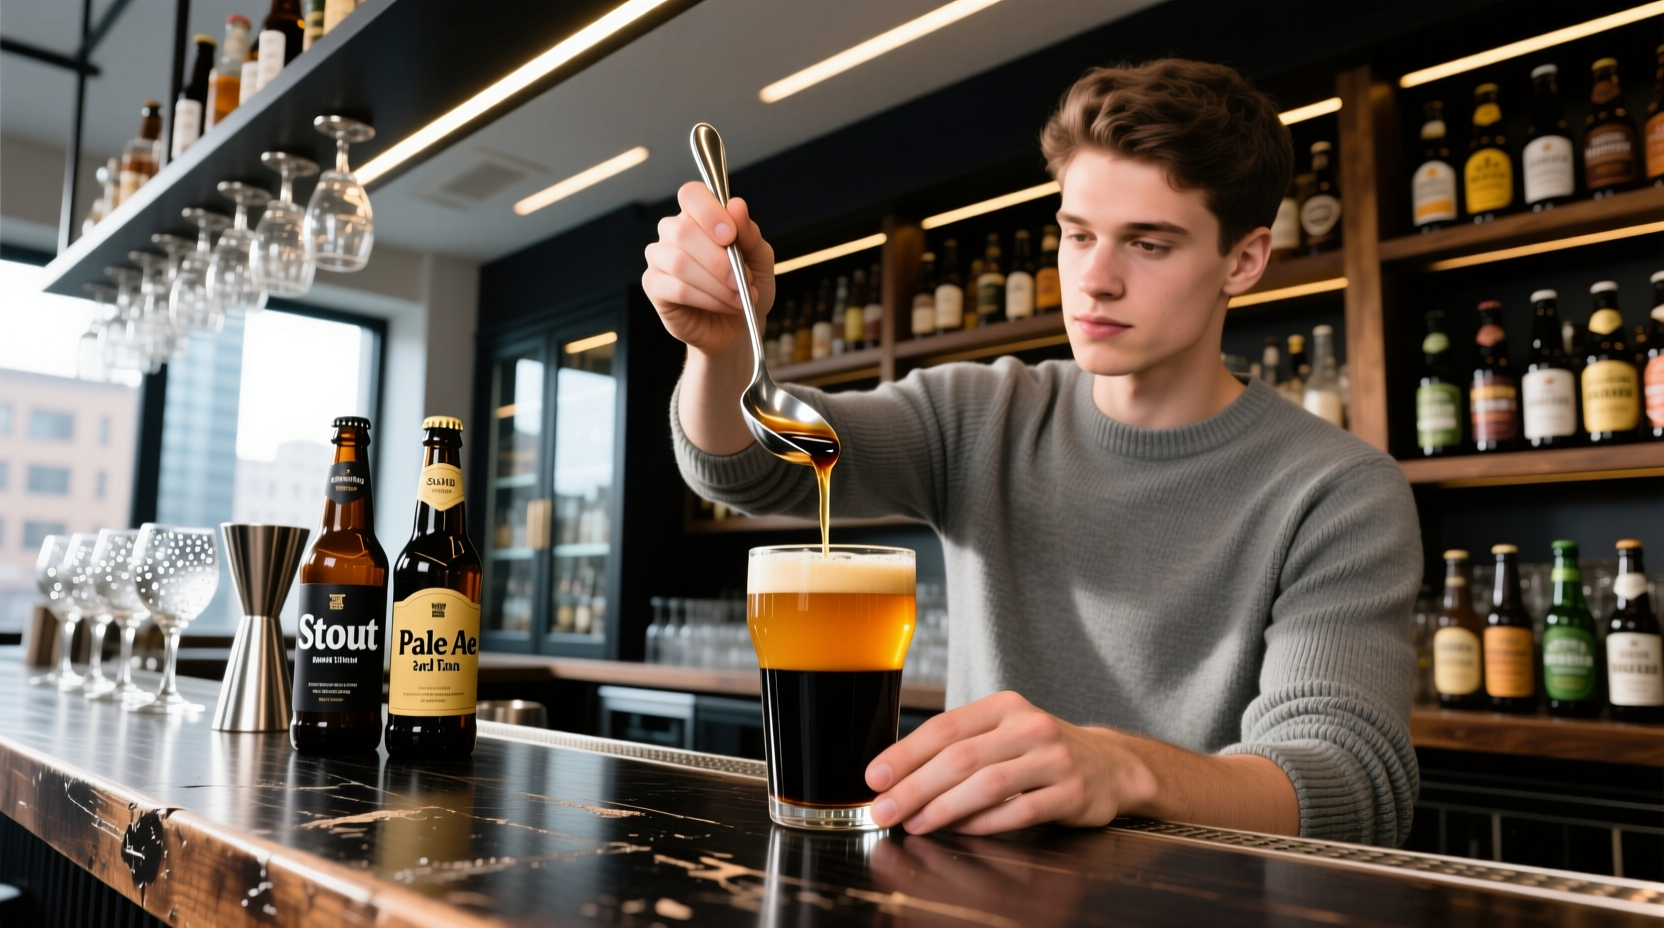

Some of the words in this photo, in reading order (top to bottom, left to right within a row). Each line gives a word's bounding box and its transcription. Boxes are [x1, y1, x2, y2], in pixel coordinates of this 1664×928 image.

[298, 613, 379, 651] Stout
[399, 629, 448, 656] Pale
[450, 629, 477, 656] Ae
